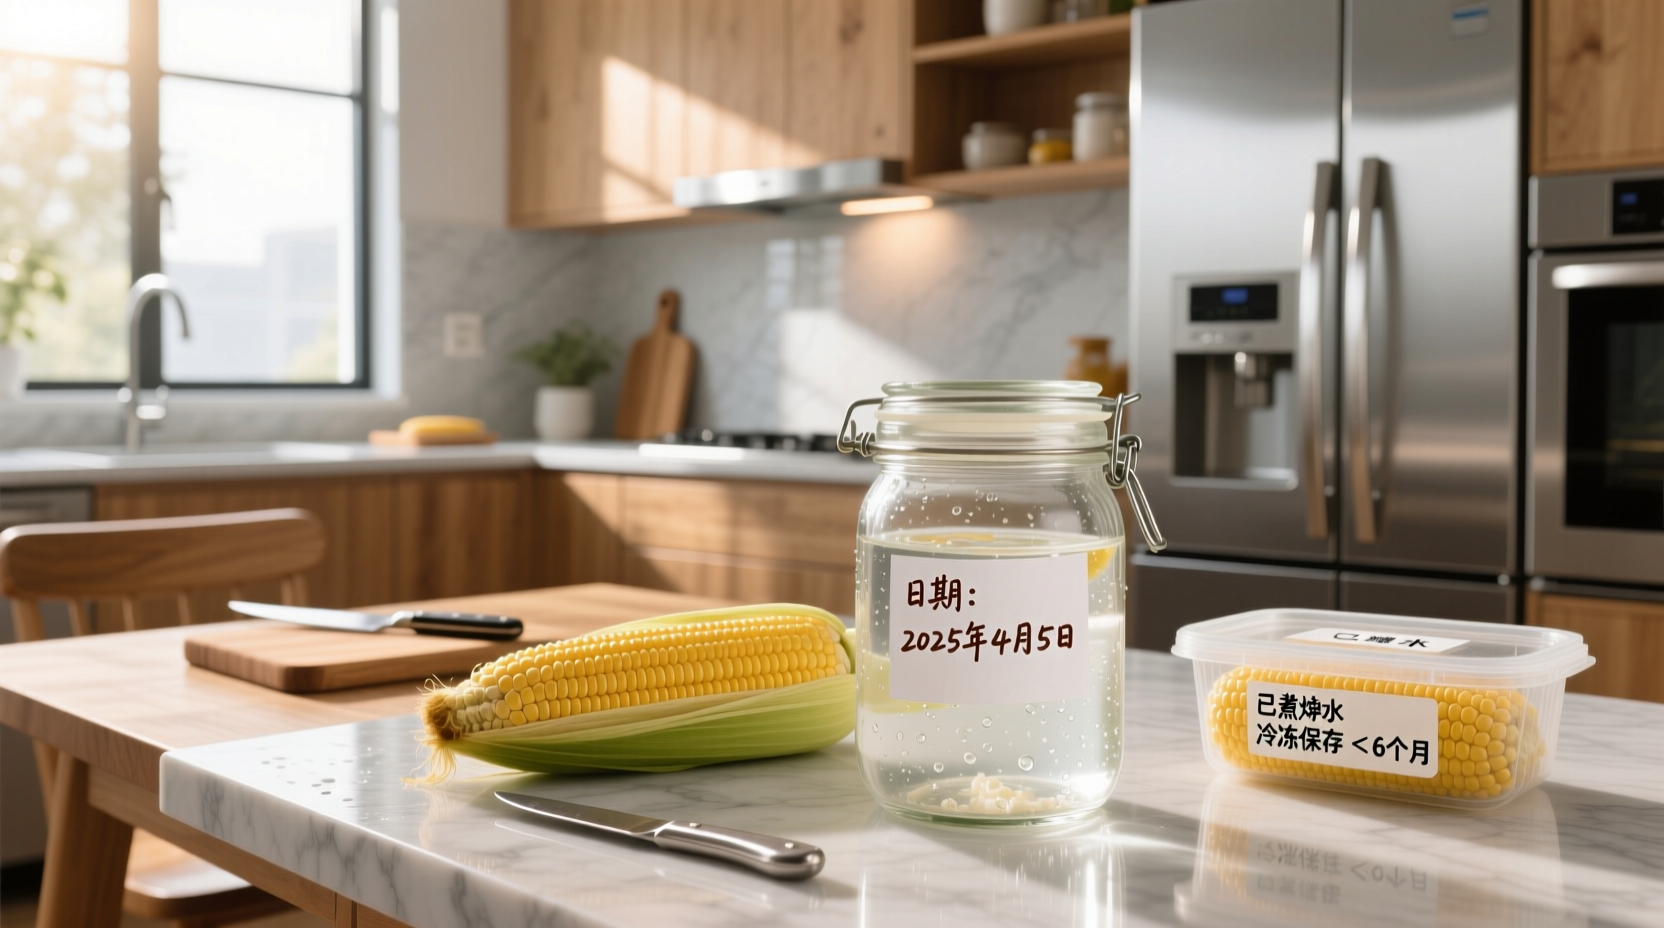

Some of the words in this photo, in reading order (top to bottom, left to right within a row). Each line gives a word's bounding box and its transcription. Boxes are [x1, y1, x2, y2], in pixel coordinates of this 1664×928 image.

[907, 574, 976, 612] 日期：
[901, 621, 1073, 663] 2025年4月5日
[1256, 722, 1344, 754] 冷冻保存
